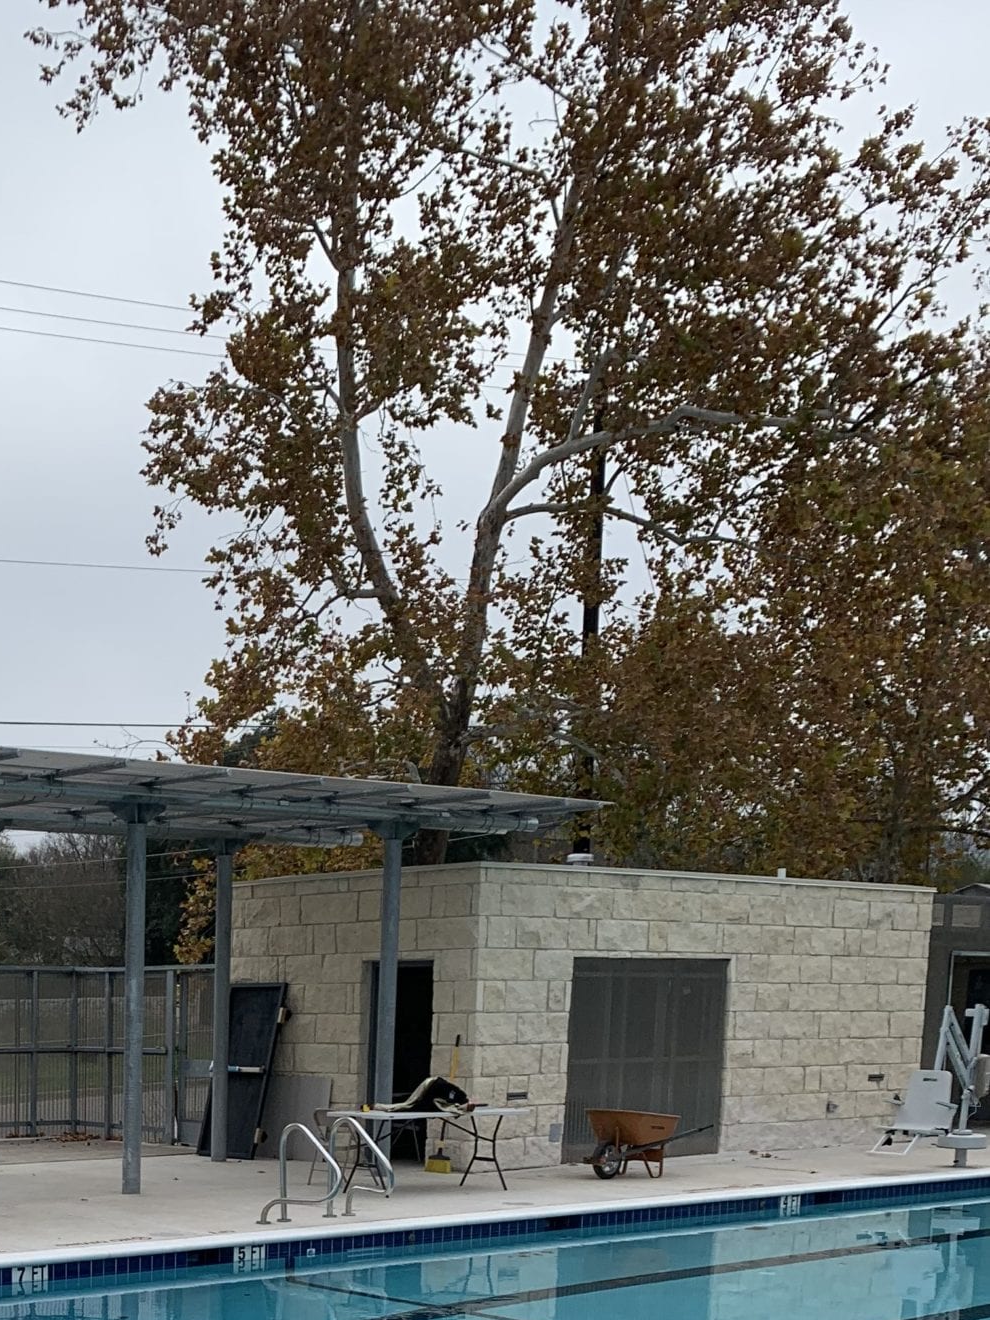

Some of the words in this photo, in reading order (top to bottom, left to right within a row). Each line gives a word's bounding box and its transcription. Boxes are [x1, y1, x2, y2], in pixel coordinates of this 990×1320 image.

[238, 1246, 246, 1261] 5
[251, 1244, 264, 1261] FT
[17, 1267, 26, 1283] 7
[31, 1265, 47, 1283] FT
